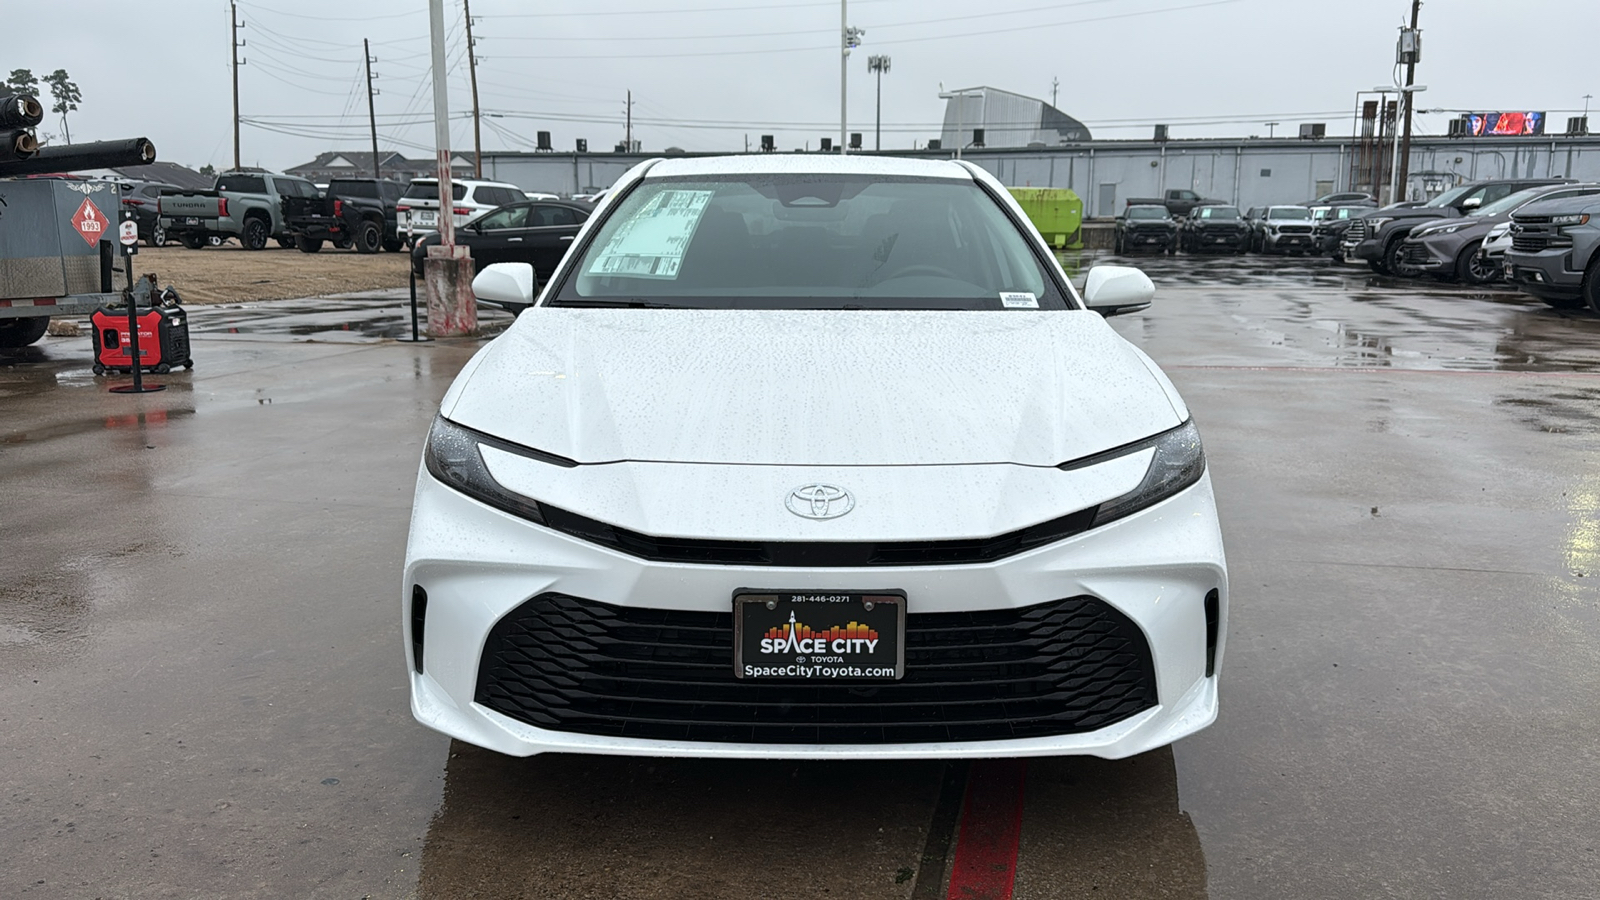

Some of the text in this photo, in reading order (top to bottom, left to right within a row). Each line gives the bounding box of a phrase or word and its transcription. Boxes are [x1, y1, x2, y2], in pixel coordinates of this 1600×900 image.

[82, 222, 100, 231] 1993
[760, 637, 879, 654] SPACE CITY
[811, 655, 844, 663] TOYOTA
[744, 664, 895, 678] SpaceCityToyota.com
